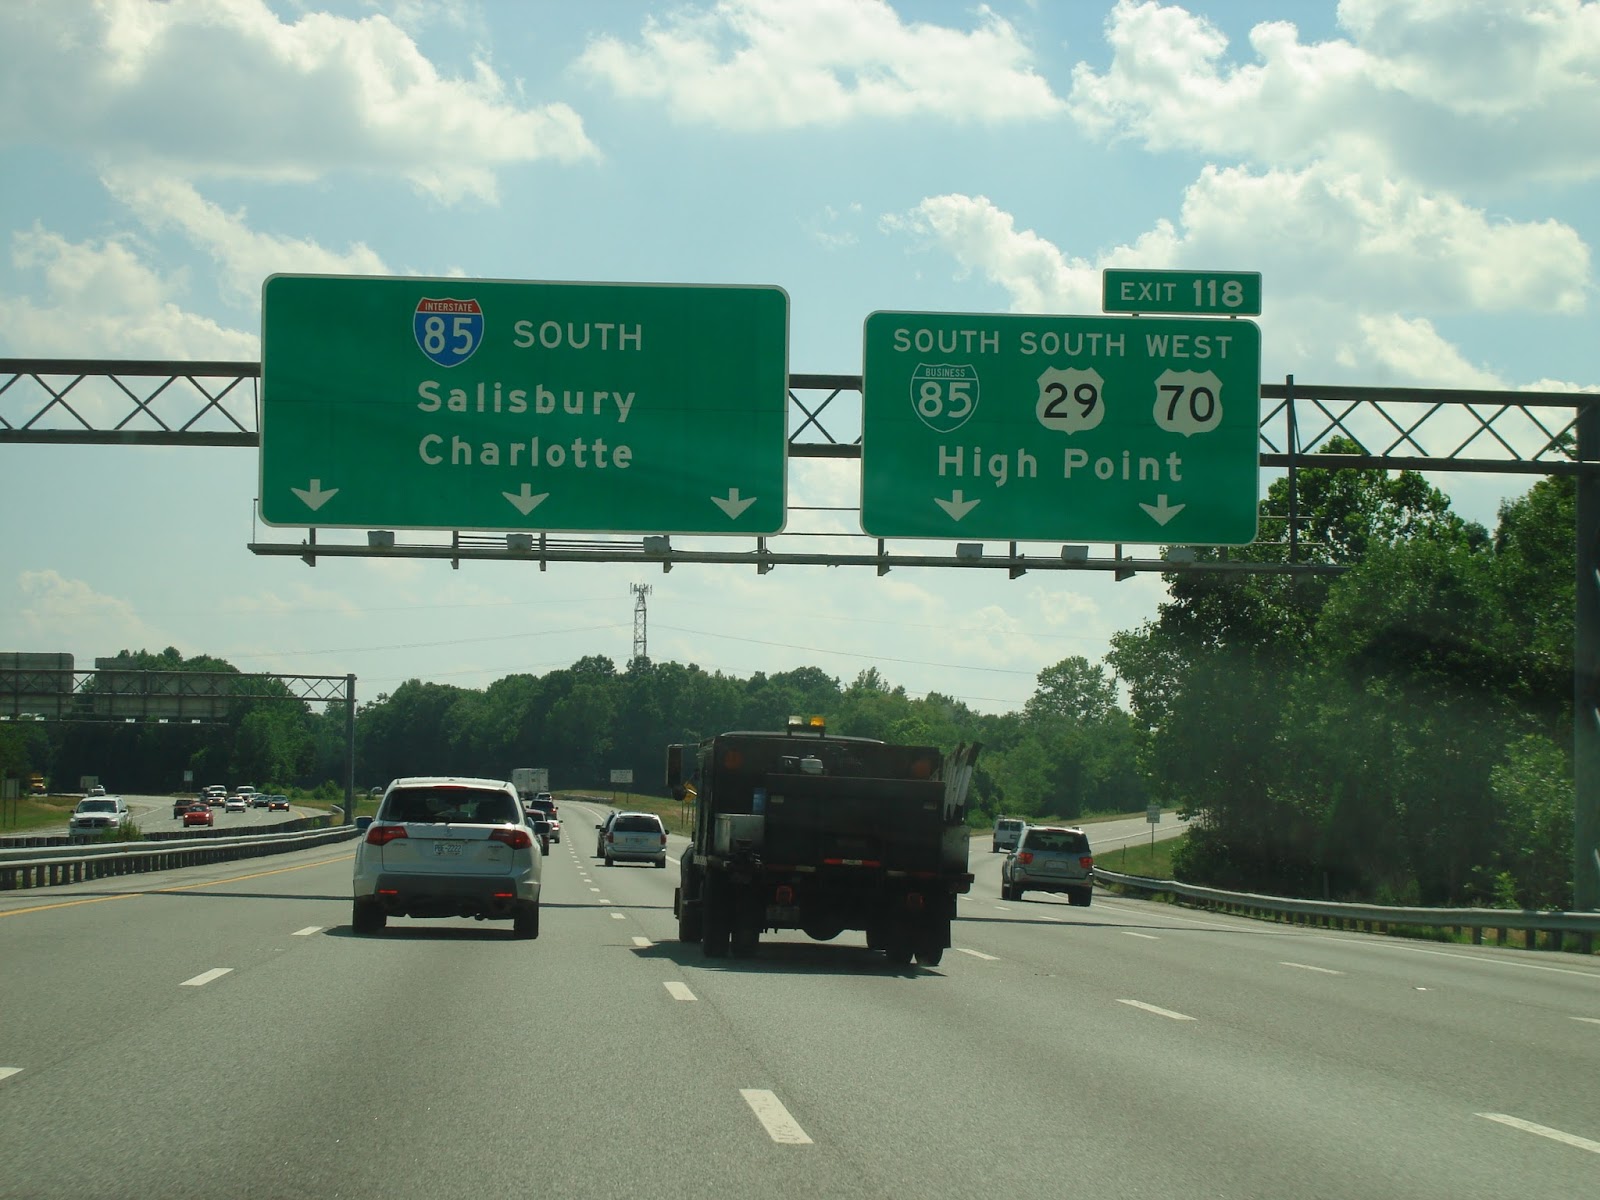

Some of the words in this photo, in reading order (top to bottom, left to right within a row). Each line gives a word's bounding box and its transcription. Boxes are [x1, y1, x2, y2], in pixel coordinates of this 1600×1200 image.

[425, 302, 473, 312] INTERSTATE
[1120, 281, 1177, 302] EXIT
[1193, 279, 1244, 307] 118
[424, 316, 473, 355] 85
[513, 320, 642, 350] SOUTH
[893, 328, 999, 354] SOUTH
[1020, 331, 1126, 357] SOUTH
[1146, 334, 1233, 359] WEST
[925, 367, 966, 378] BUSINESS
[417, 380, 635, 423] Salisbury
[918, 381, 972, 418] 85
[1043, 382, 1098, 419] 29
[1159, 385, 1215, 422] 70
[418, 434, 633, 469] Charlotte
[938, 445, 1037, 488] High
[1064, 448, 1182, 482] Point
